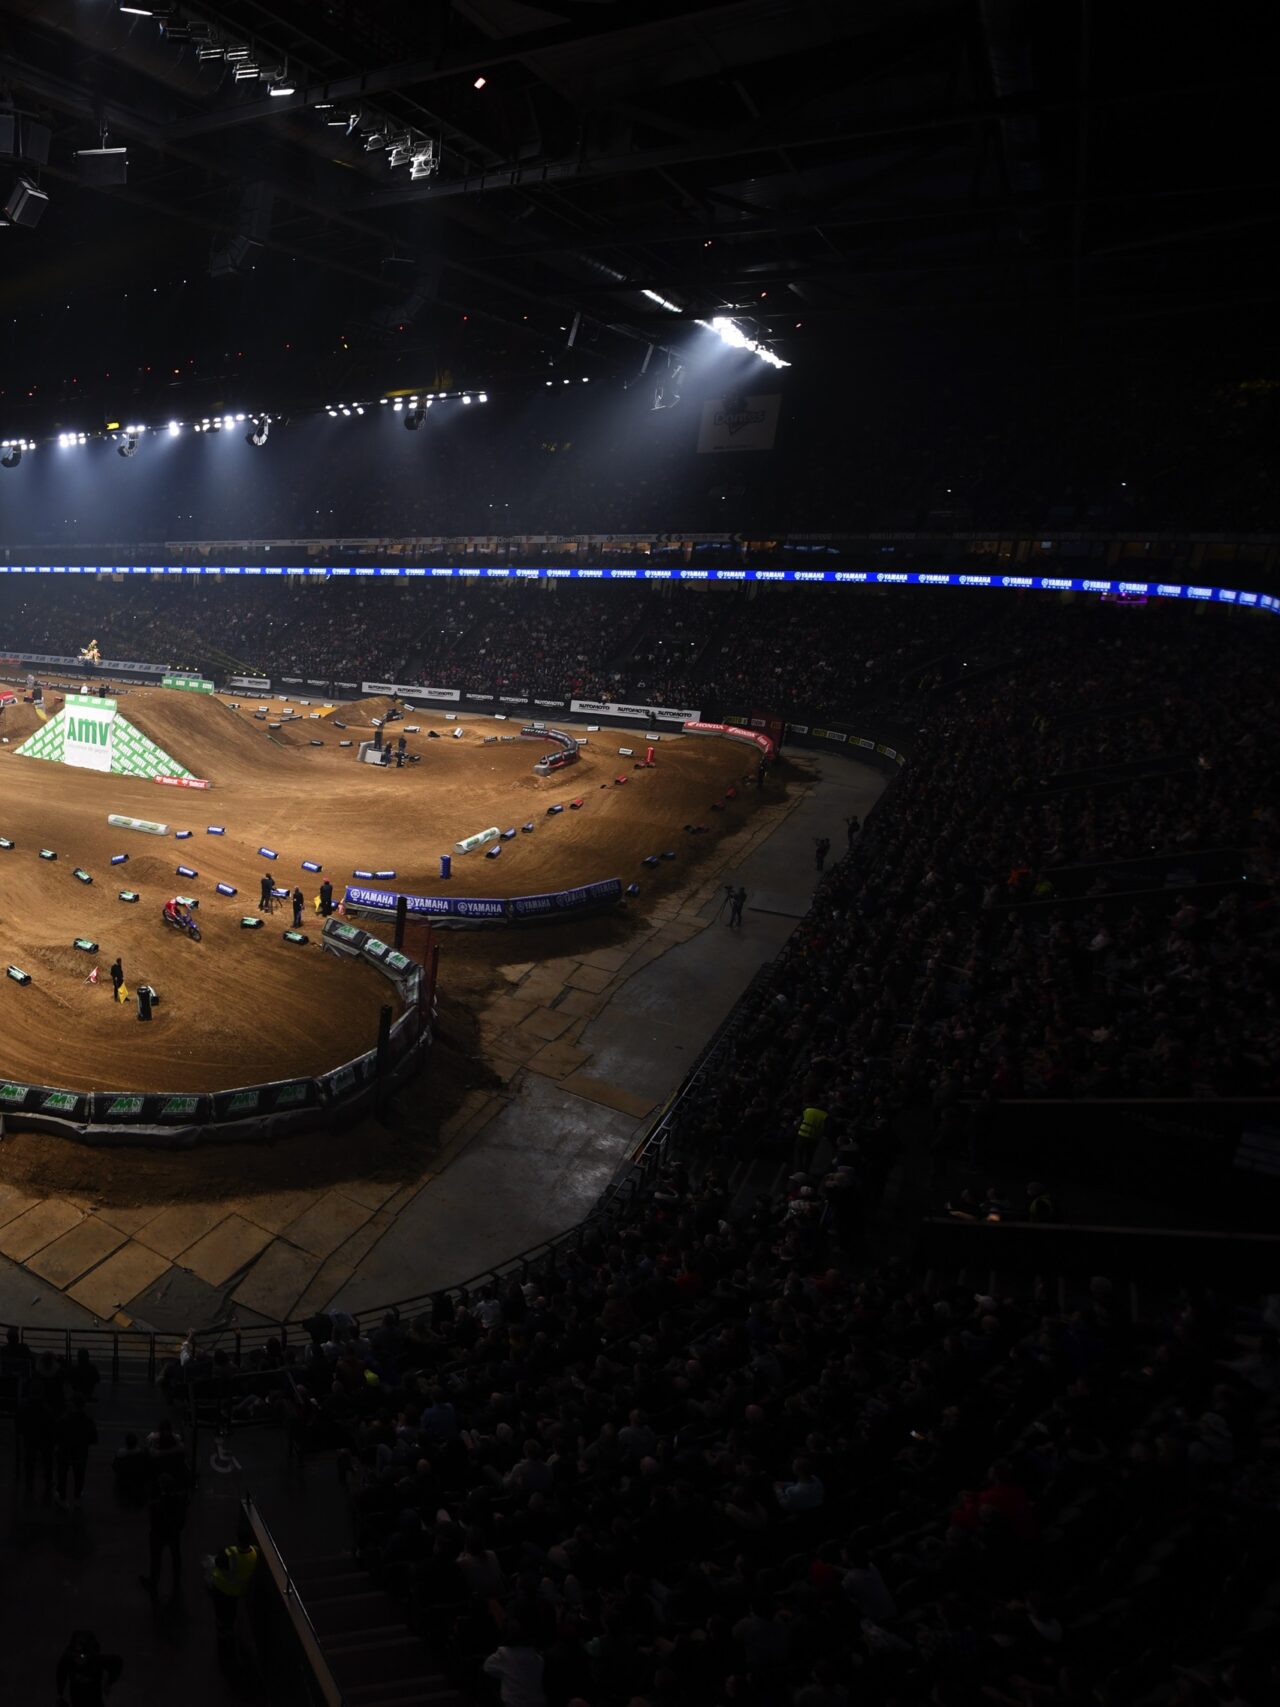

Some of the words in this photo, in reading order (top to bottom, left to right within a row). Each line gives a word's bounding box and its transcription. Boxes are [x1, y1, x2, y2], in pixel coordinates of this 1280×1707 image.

[617, 706, 650, 714] AUTOMOTO
[657, 710, 692, 718] AUTOMOTO
[360, 891, 394, 905] YAMAHA
[414, 898, 449, 911] YAMAHA
[467, 902, 502, 913] YAMAHA
[523, 898, 551, 910] YAMAHA
